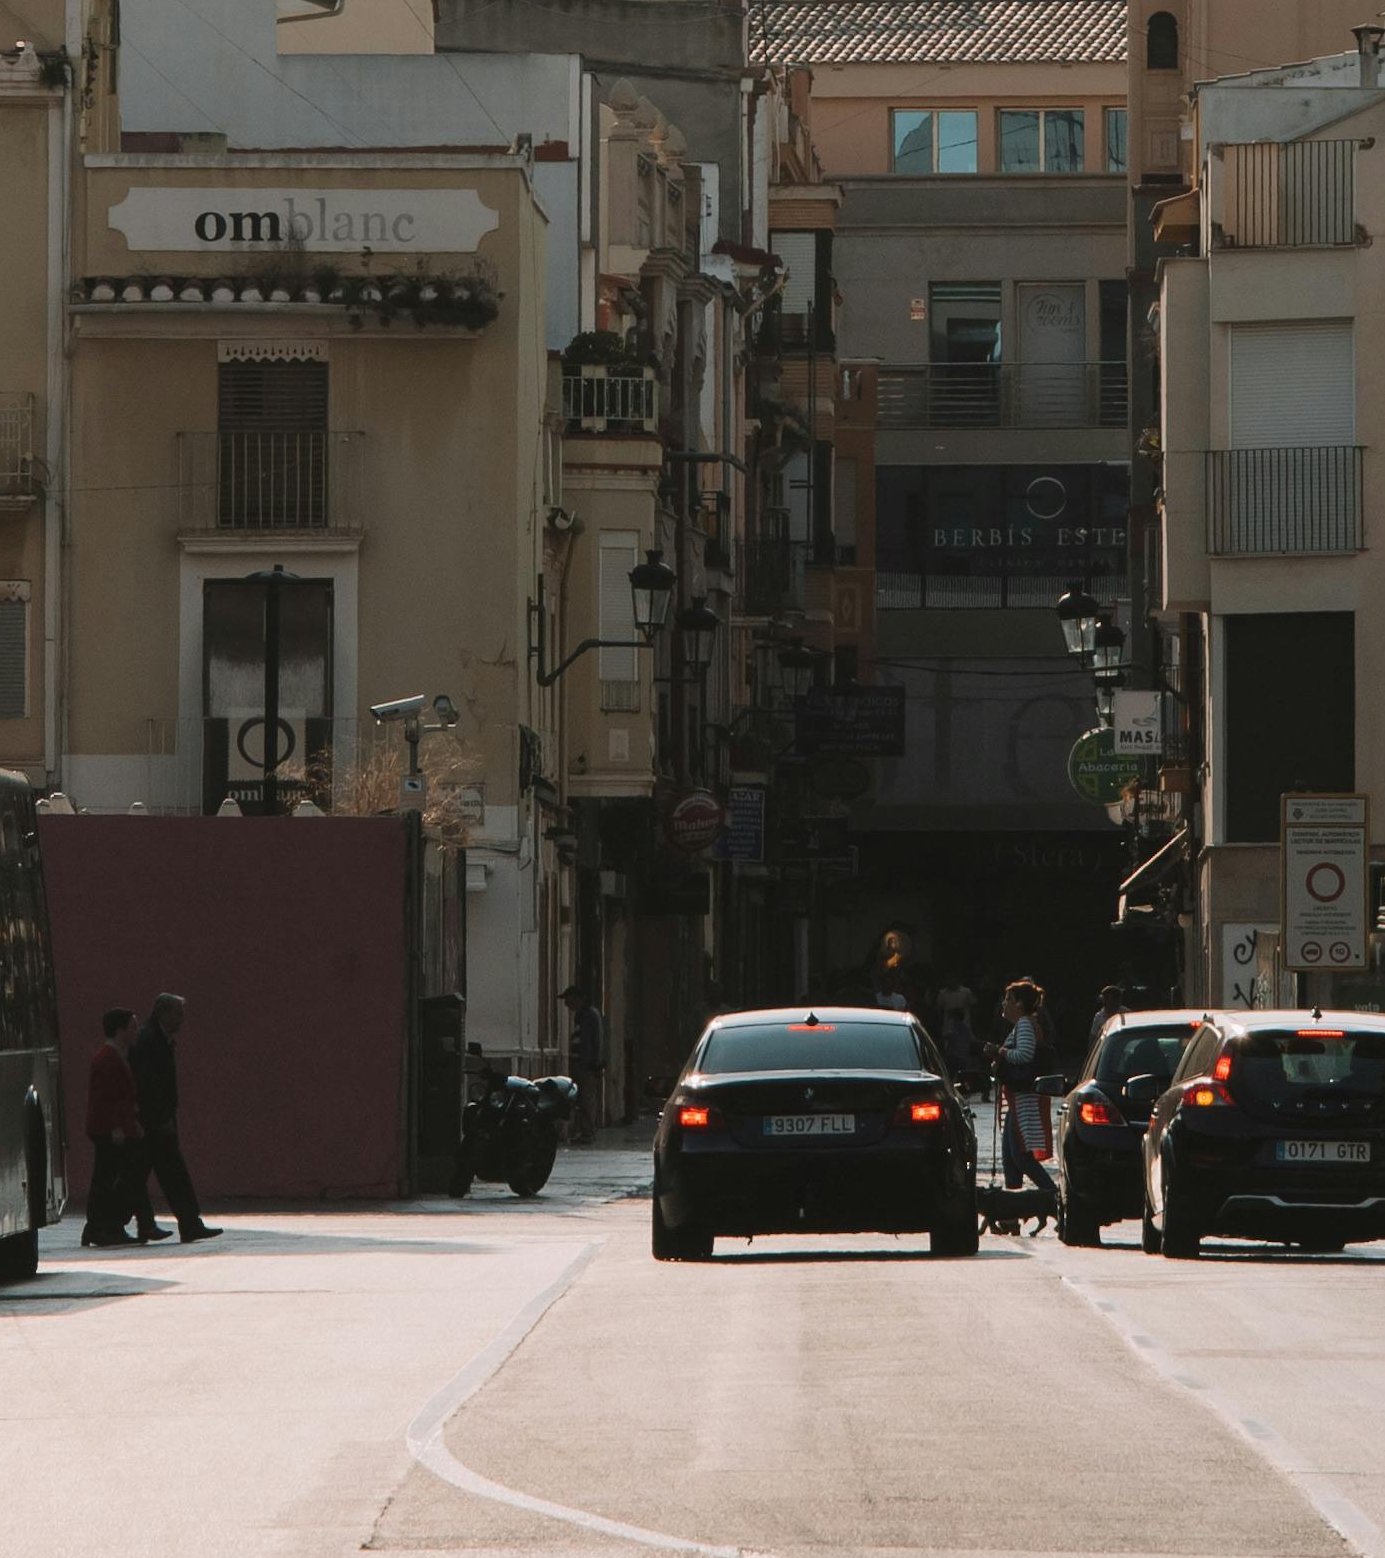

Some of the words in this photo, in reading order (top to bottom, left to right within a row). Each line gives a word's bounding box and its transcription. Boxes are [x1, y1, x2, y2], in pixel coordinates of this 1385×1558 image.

[194, 197, 416, 242] omblanc
[934, 523, 1031, 546] BERBÍS
[774, 1117, 815, 1133] 9307
[820, 1116, 852, 1132] FLL
[1288, 1142, 1325, 1158] 0171
[1337, 1143, 1367, 1159] GTR
